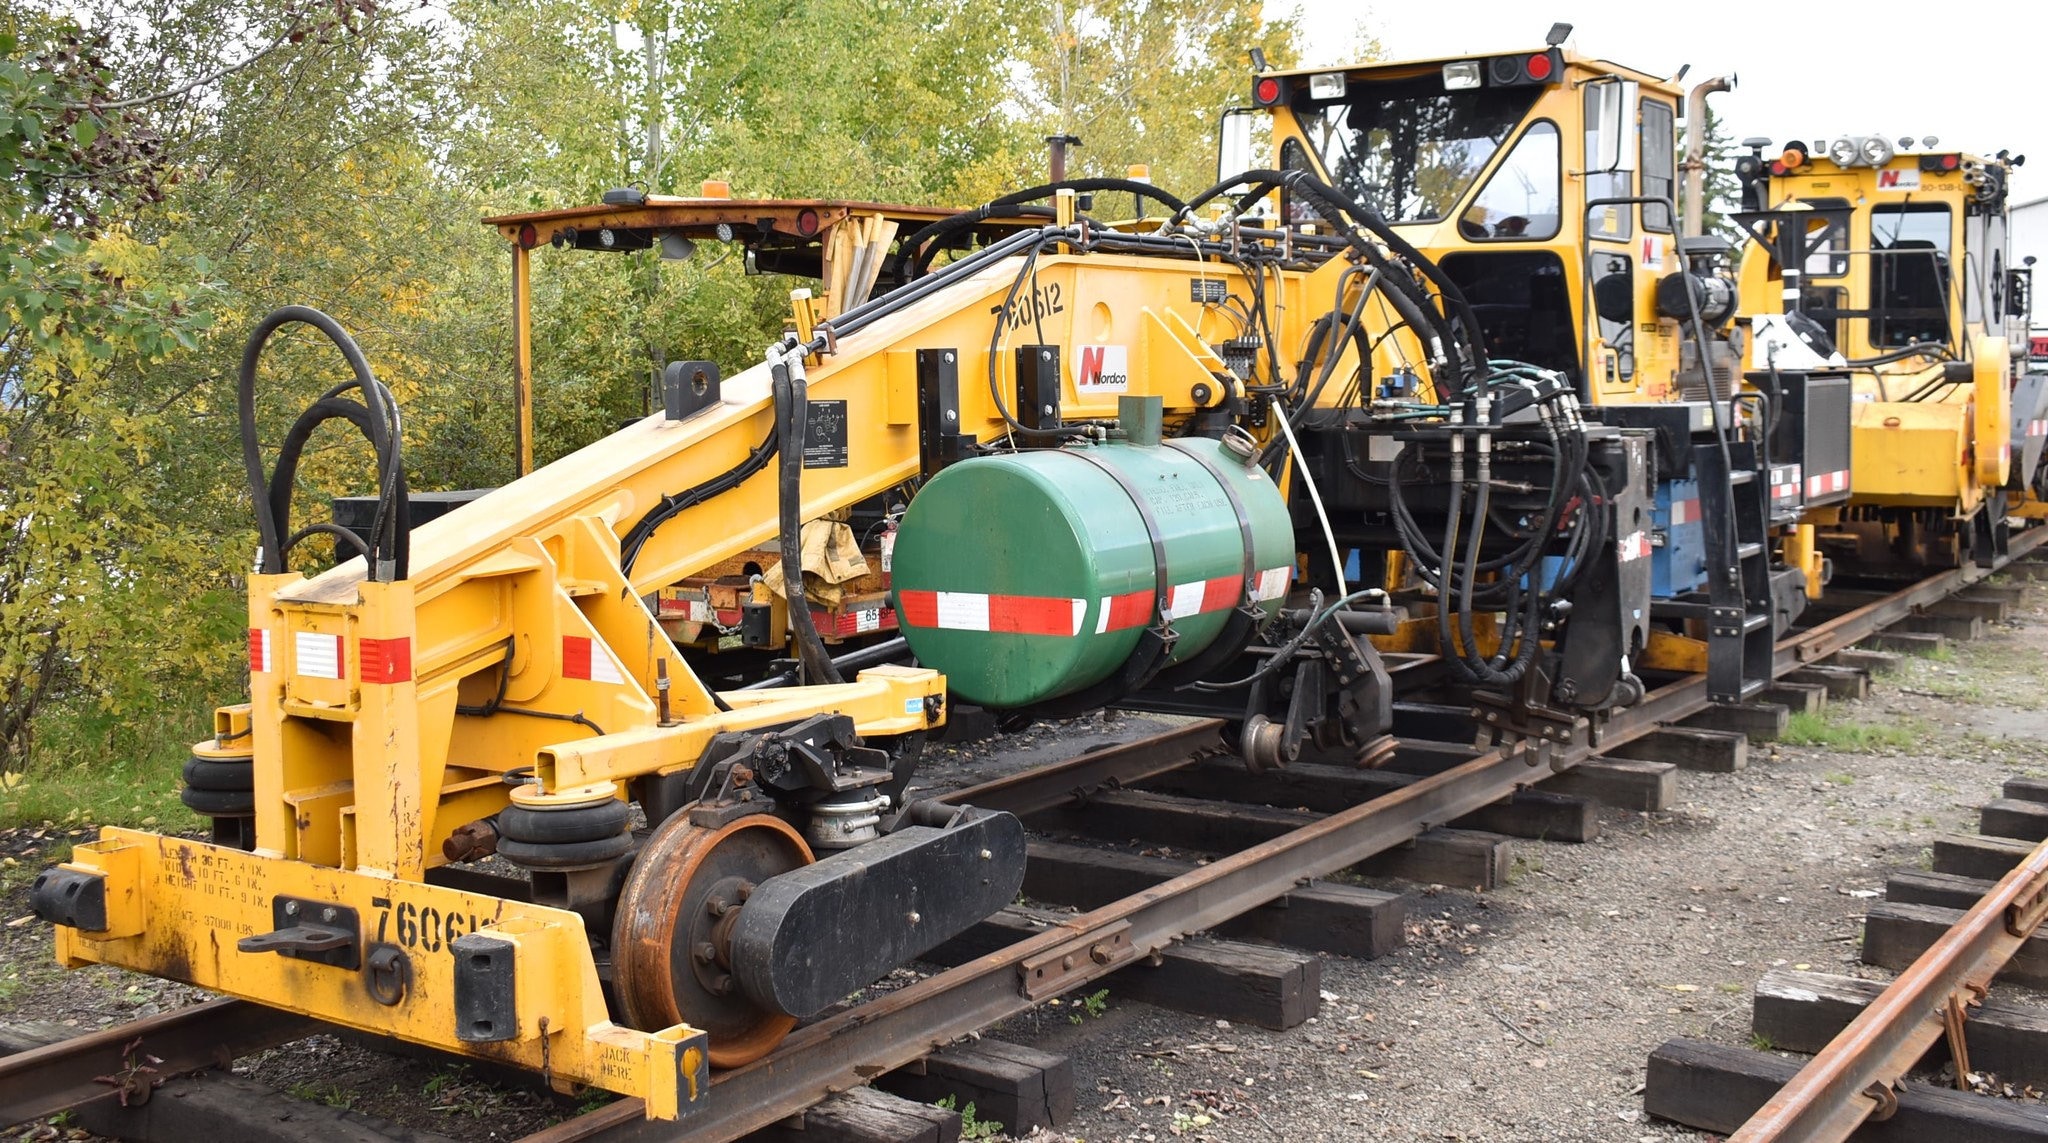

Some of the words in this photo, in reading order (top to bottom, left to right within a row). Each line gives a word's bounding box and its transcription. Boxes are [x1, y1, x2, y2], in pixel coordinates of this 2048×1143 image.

[1093, 371, 1127, 386] Nordco
[164, 847, 198, 864] LENH
[201, 854, 213, 867] 36
[217, 857, 234, 871] FT.
[239, 861, 246, 873] 4
[198, 866, 209, 879] 10
[213, 869, 229, 884] FT.
[234, 874, 241, 886] 6
[164, 873, 198, 892] HEIGHT
[204, 883, 215, 895] 10
[219, 886, 235, 901] FT.
[240, 892, 247, 904] 9
[601, 1046, 631, 1064] JACK
[601, 1061, 632, 1081] HERE
